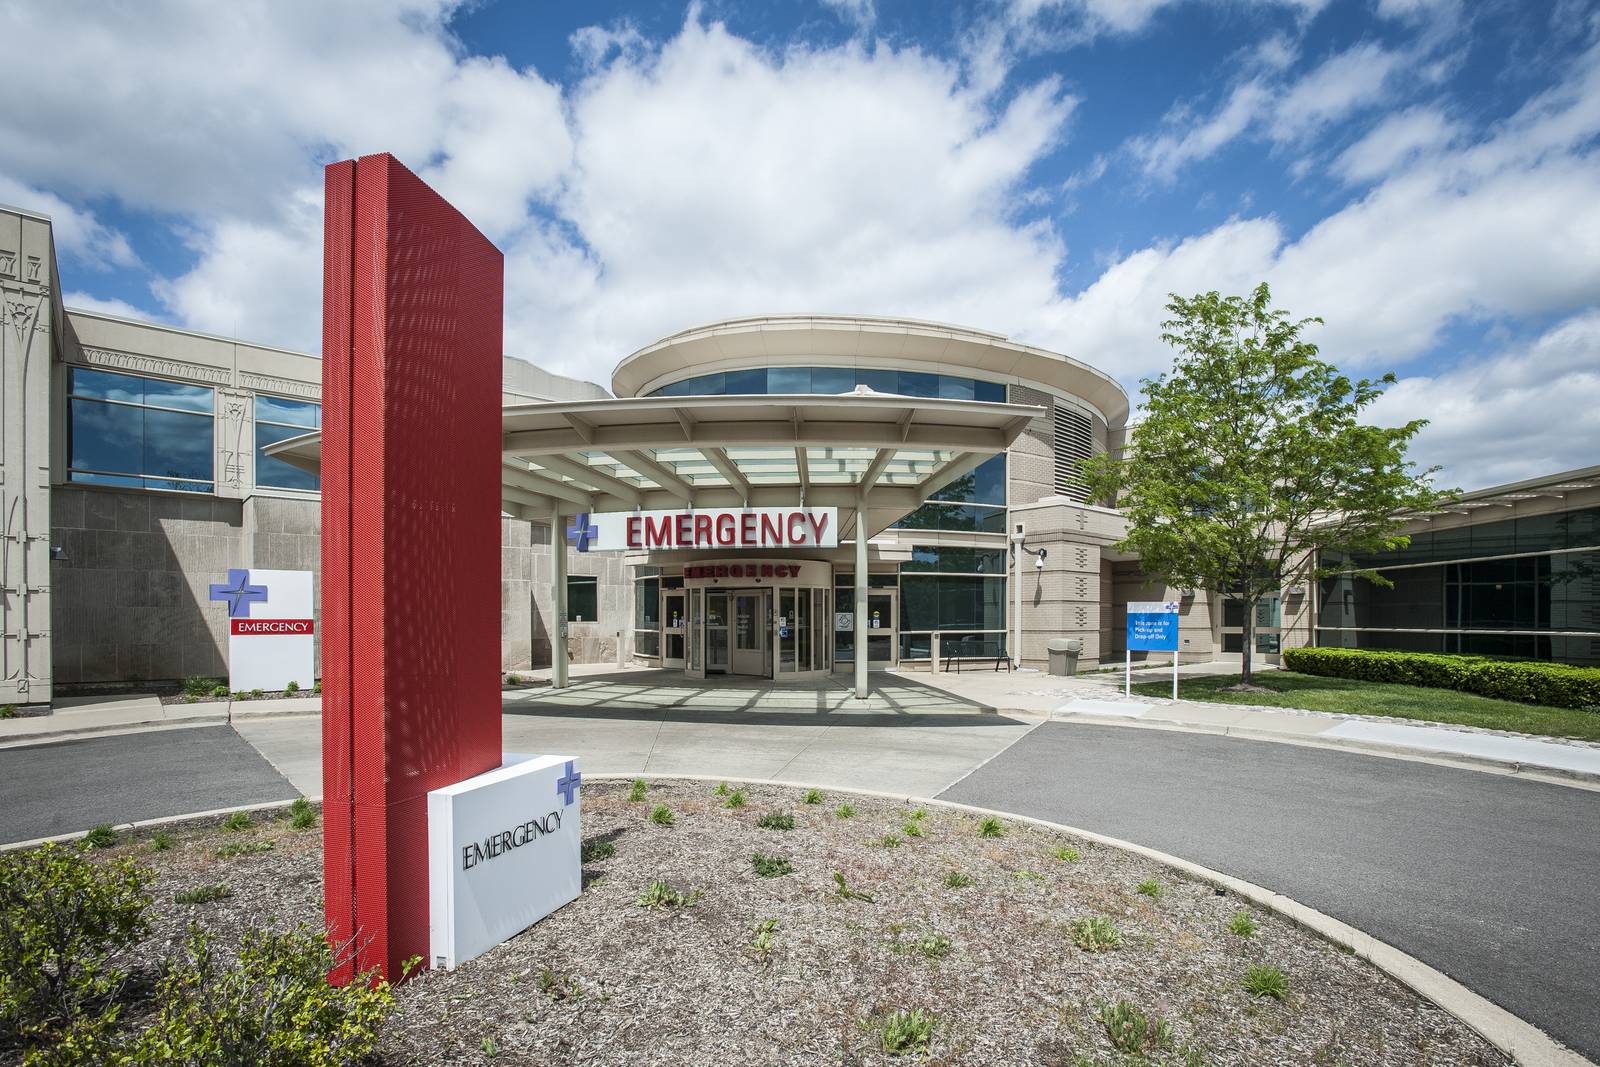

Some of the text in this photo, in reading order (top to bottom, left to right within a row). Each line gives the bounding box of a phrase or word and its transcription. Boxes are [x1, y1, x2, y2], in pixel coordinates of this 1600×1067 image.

[626, 512, 829, 547] EMERGENCY
[684, 564, 802, 579] EMERGENCY
[238, 622, 308, 632] EMERGENCY
[463, 808, 564, 871] EMERGENCY
